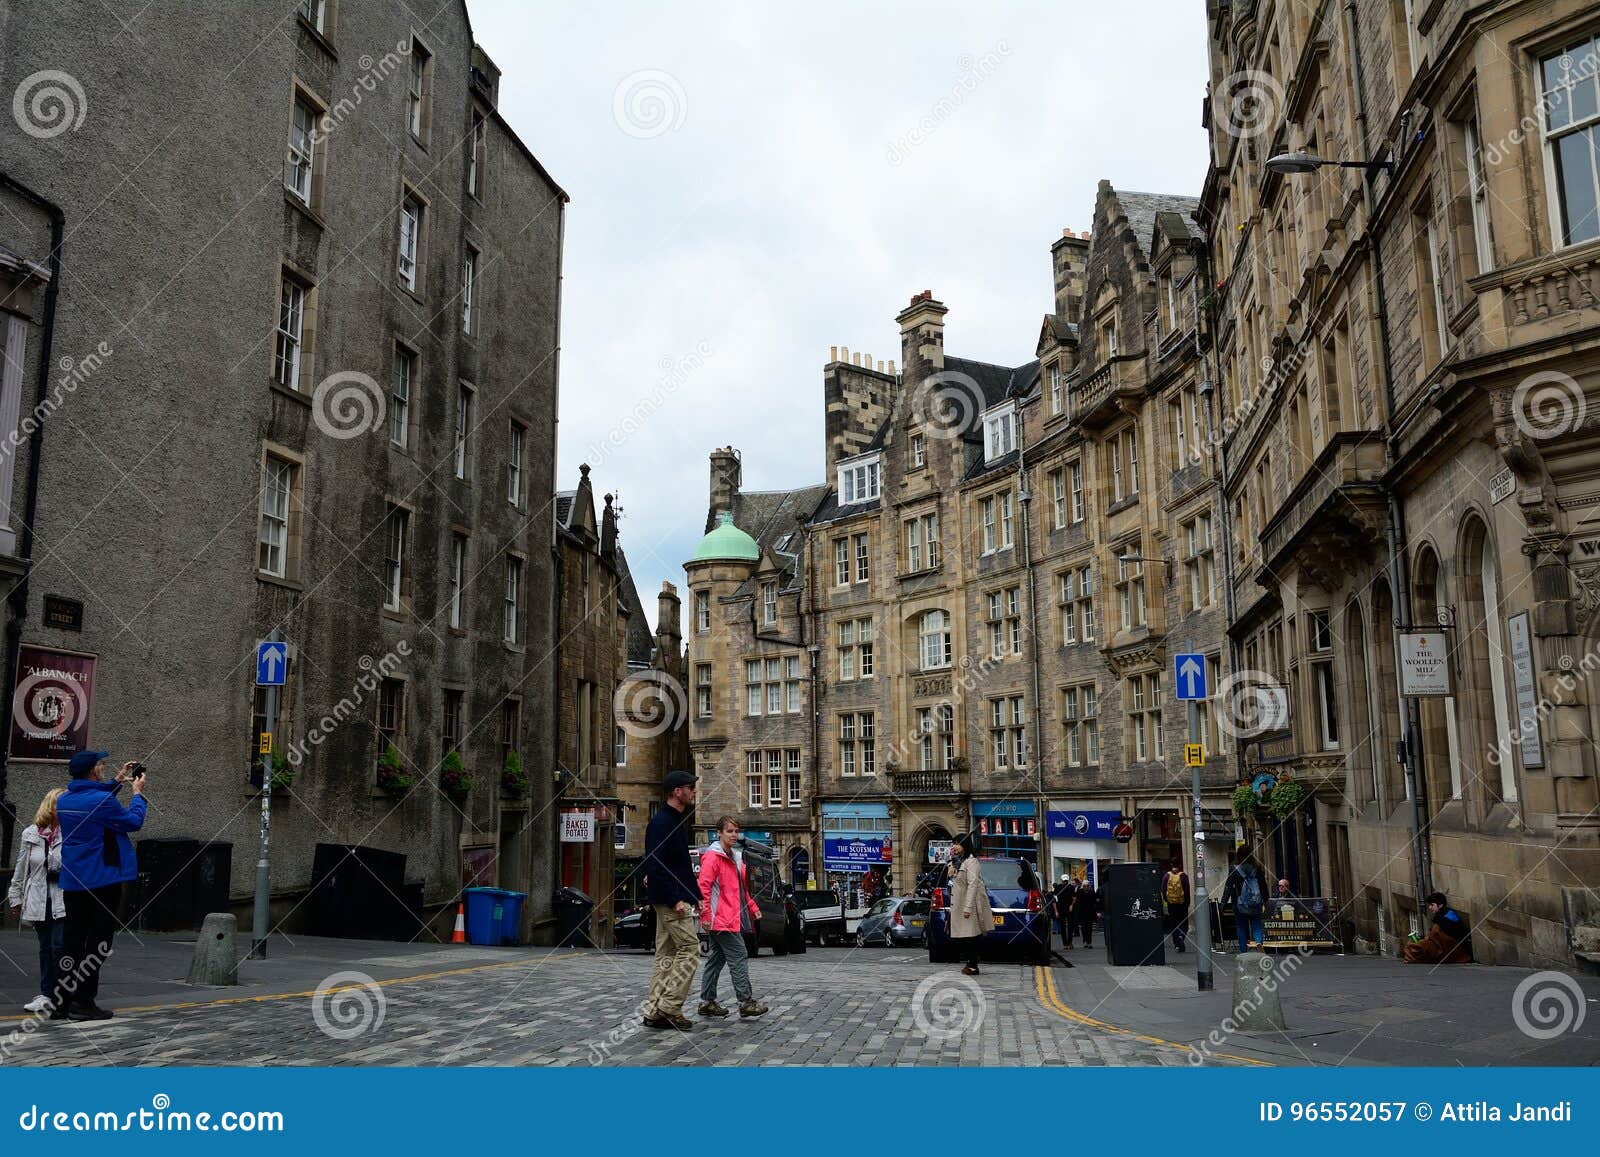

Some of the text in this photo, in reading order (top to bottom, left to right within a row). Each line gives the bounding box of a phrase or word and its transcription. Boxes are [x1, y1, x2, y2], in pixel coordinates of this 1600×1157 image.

[27, 666, 88, 682] ALBANACH
[565, 820, 589, 829] BAKED
[565, 829, 589, 837] POTATO
